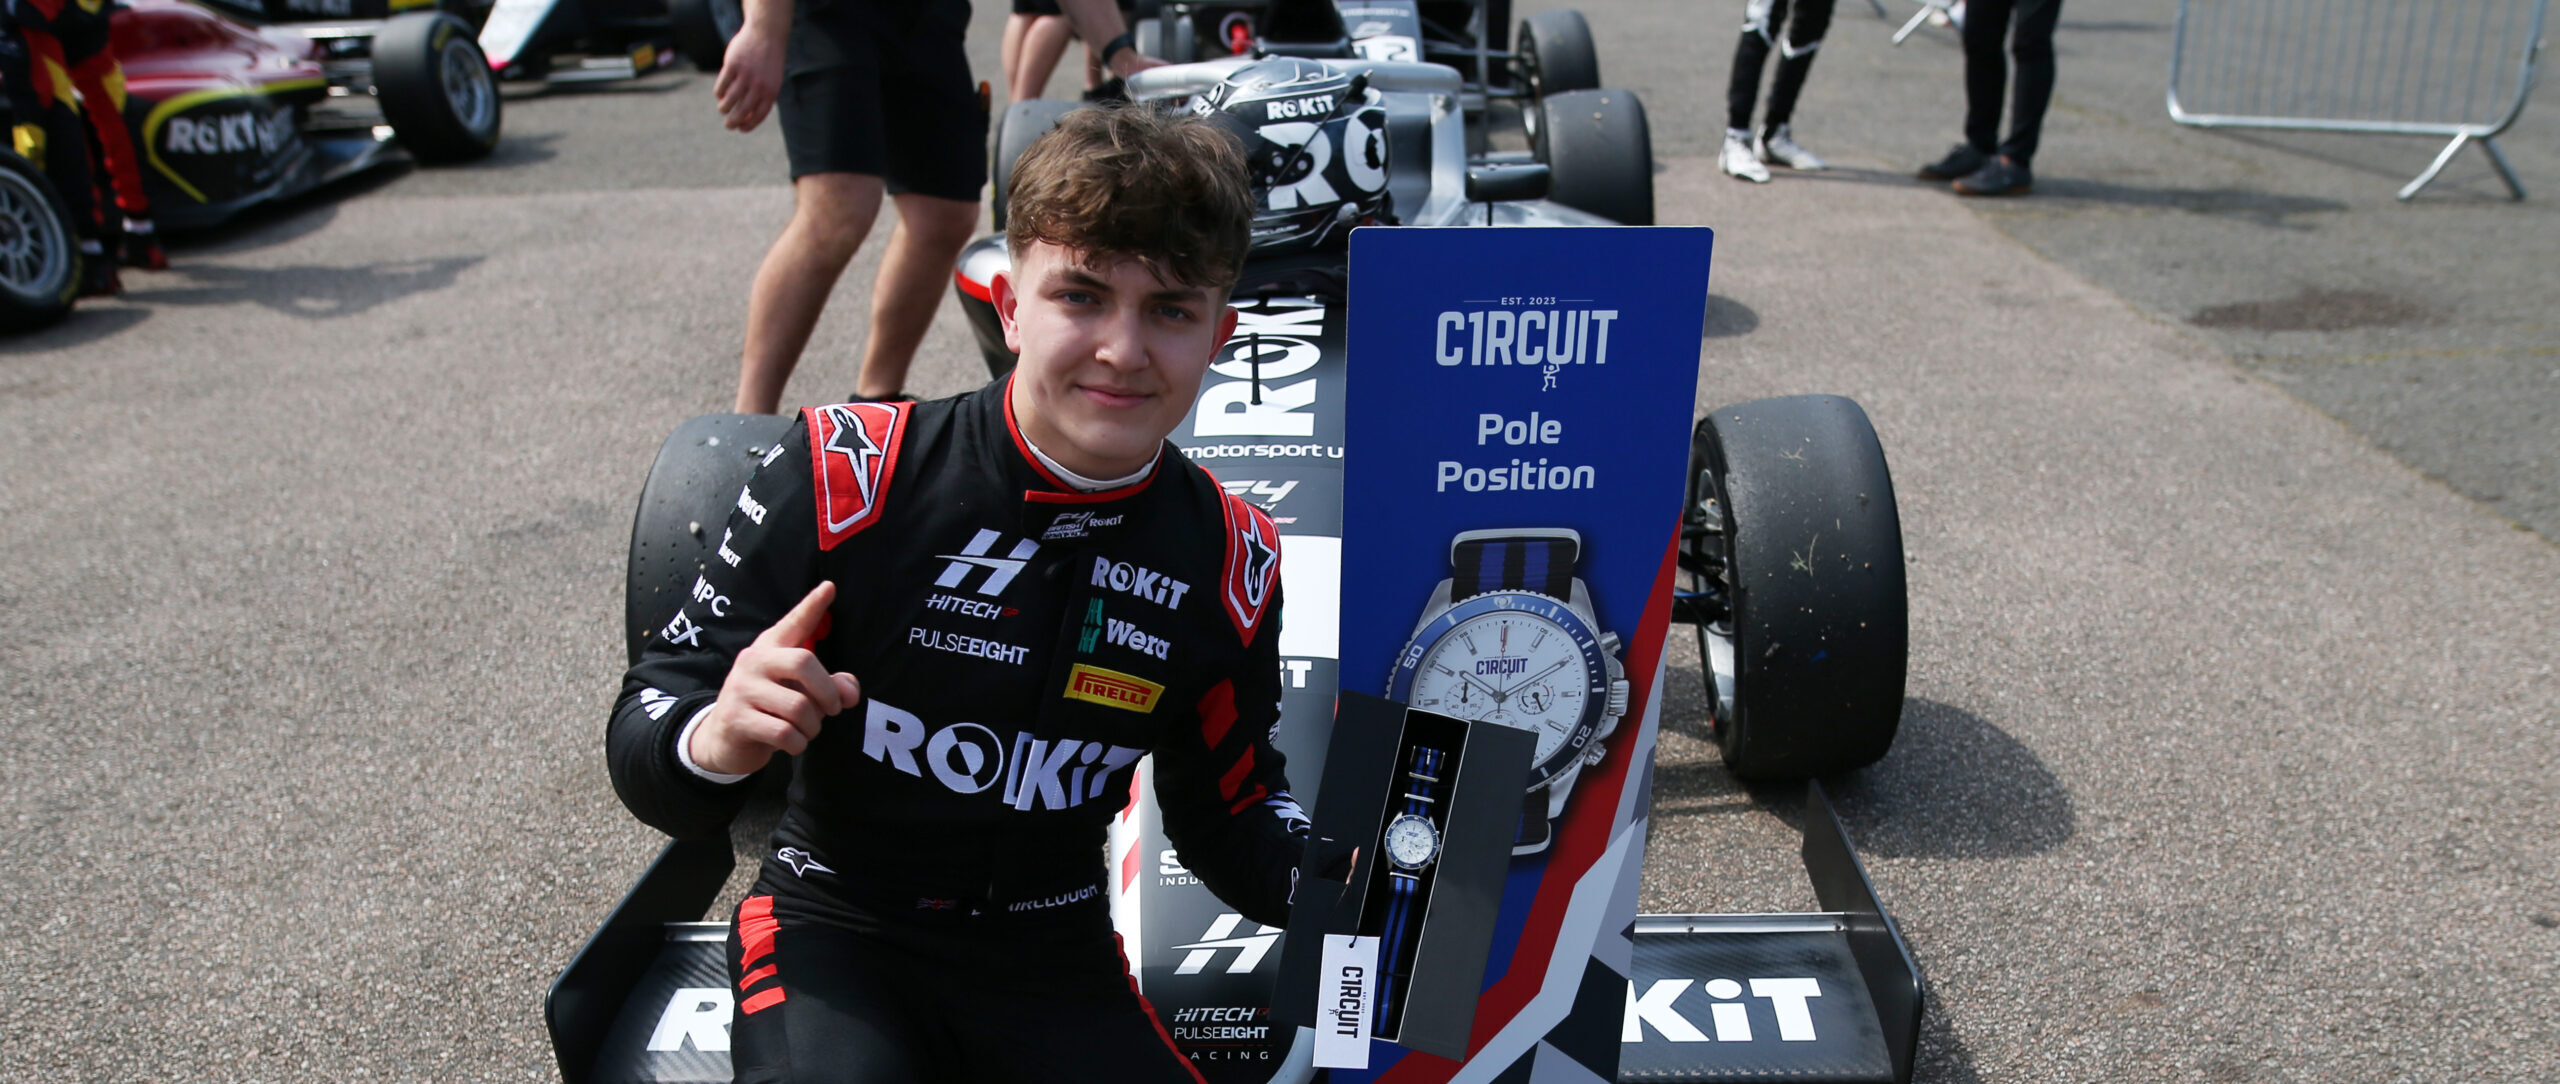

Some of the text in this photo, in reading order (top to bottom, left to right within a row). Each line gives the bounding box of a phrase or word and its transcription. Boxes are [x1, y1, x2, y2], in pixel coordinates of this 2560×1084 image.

[1266, 95, 1334, 120] ROKiT
[1501, 296, 1556, 306] EST. 2023
[1478, 411, 1562, 446] Pole
[1181, 444, 1322, 458] motorsport
[1437, 458, 1595, 492] Position
[1091, 556, 1190, 610] ROKiT
[908, 627, 1030, 665] PULSEEIGHT
[1107, 617, 1171, 661] Wera
[1403, 645, 1424, 669] 50
[1074, 671, 1152, 706] PIRELLI
[863, 698, 1147, 811] ROKiT
[1159, 876, 1204, 886] INDU
[1174, 1027, 1269, 1040] PULSEEIGHT
[1190, 1051, 1269, 1060] ACING
